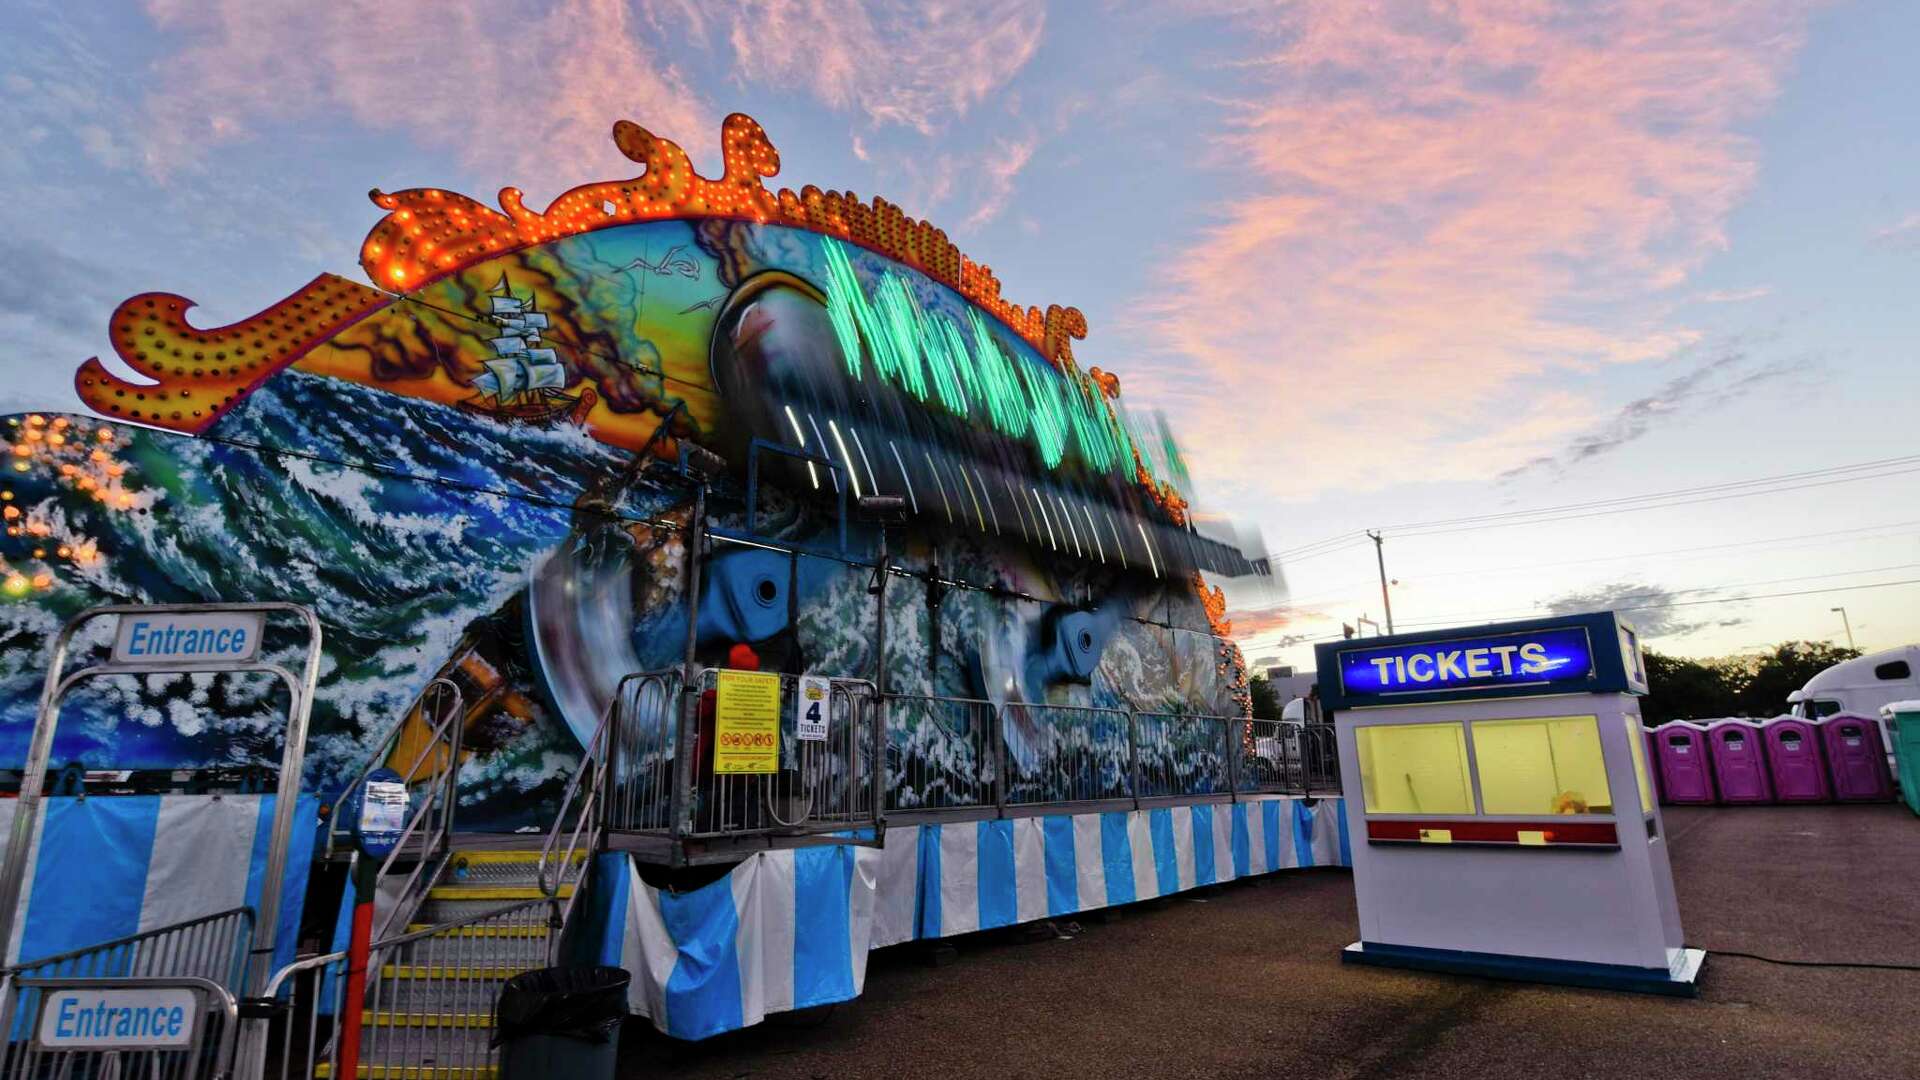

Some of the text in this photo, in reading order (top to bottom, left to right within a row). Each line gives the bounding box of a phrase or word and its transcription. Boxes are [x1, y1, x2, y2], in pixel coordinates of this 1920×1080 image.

[128, 622, 246, 655] Entrance
[1371, 643, 1547, 685] TICKETS
[800, 724, 826, 734] TICKETS
[806, 701, 821, 724] 4
[56, 998, 183, 1038] Entrance
